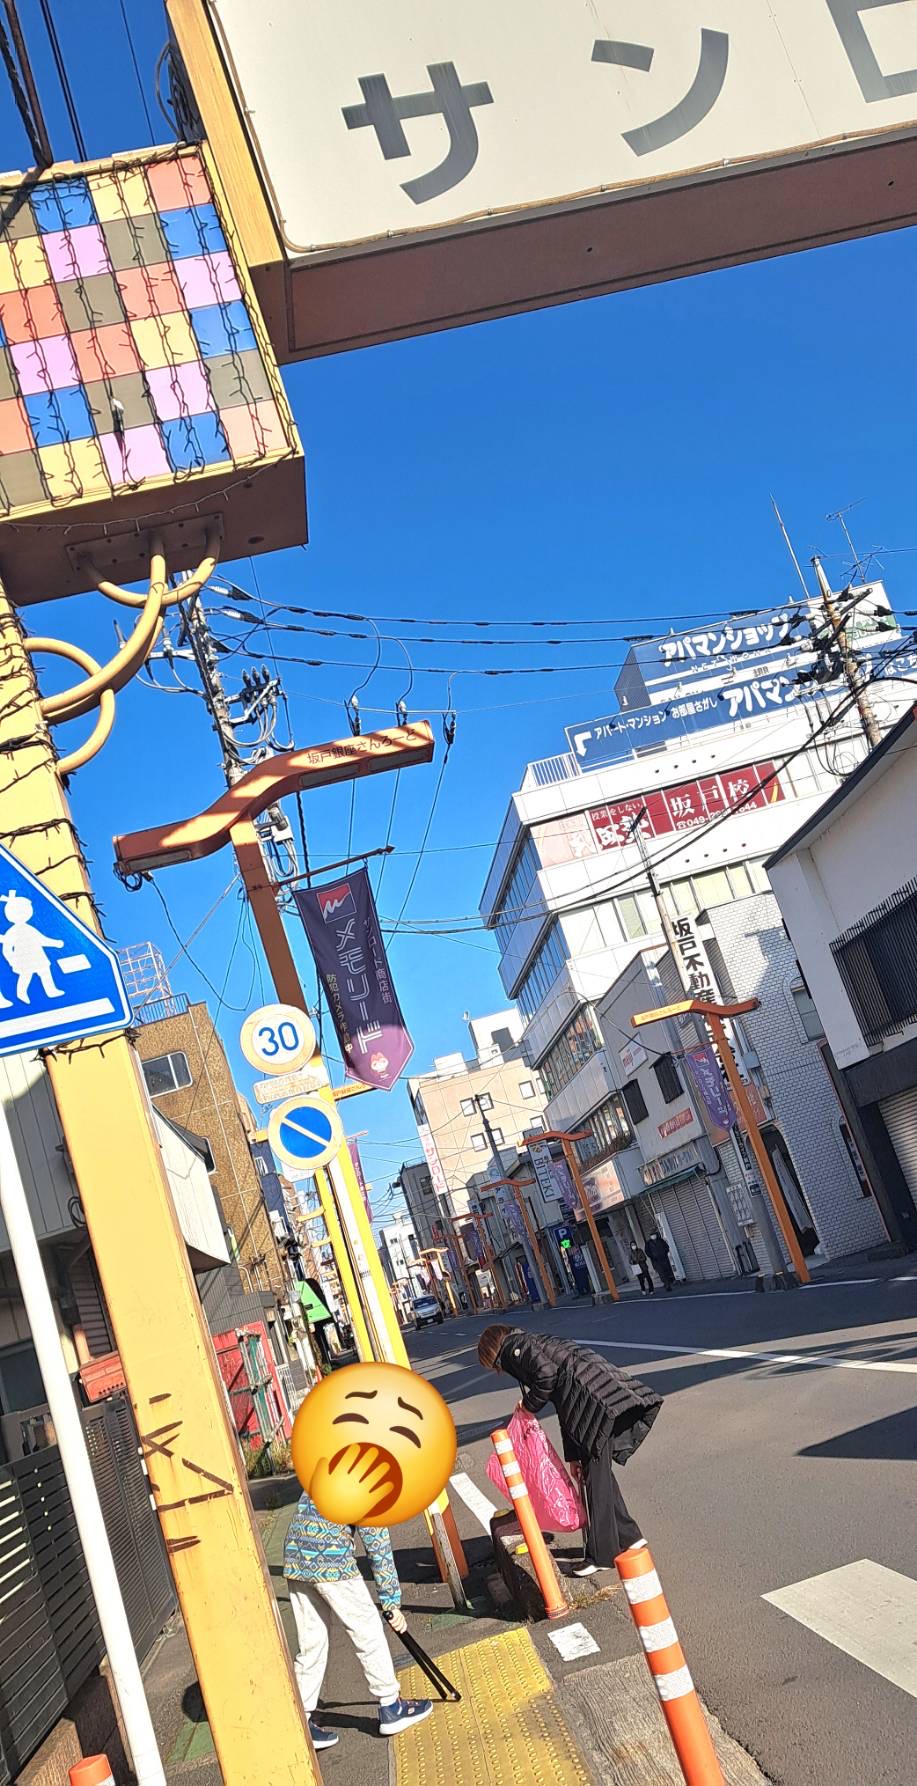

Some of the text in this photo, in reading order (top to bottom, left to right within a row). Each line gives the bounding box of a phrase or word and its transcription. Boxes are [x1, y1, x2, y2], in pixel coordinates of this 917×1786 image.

[658, 612, 790, 667] アパマンショップ
[306, 727, 417, 765] 坂戸銀座さんろーど
[335, 918, 384, 1055] メモリード
[258, 1021, 300, 1057] 30
